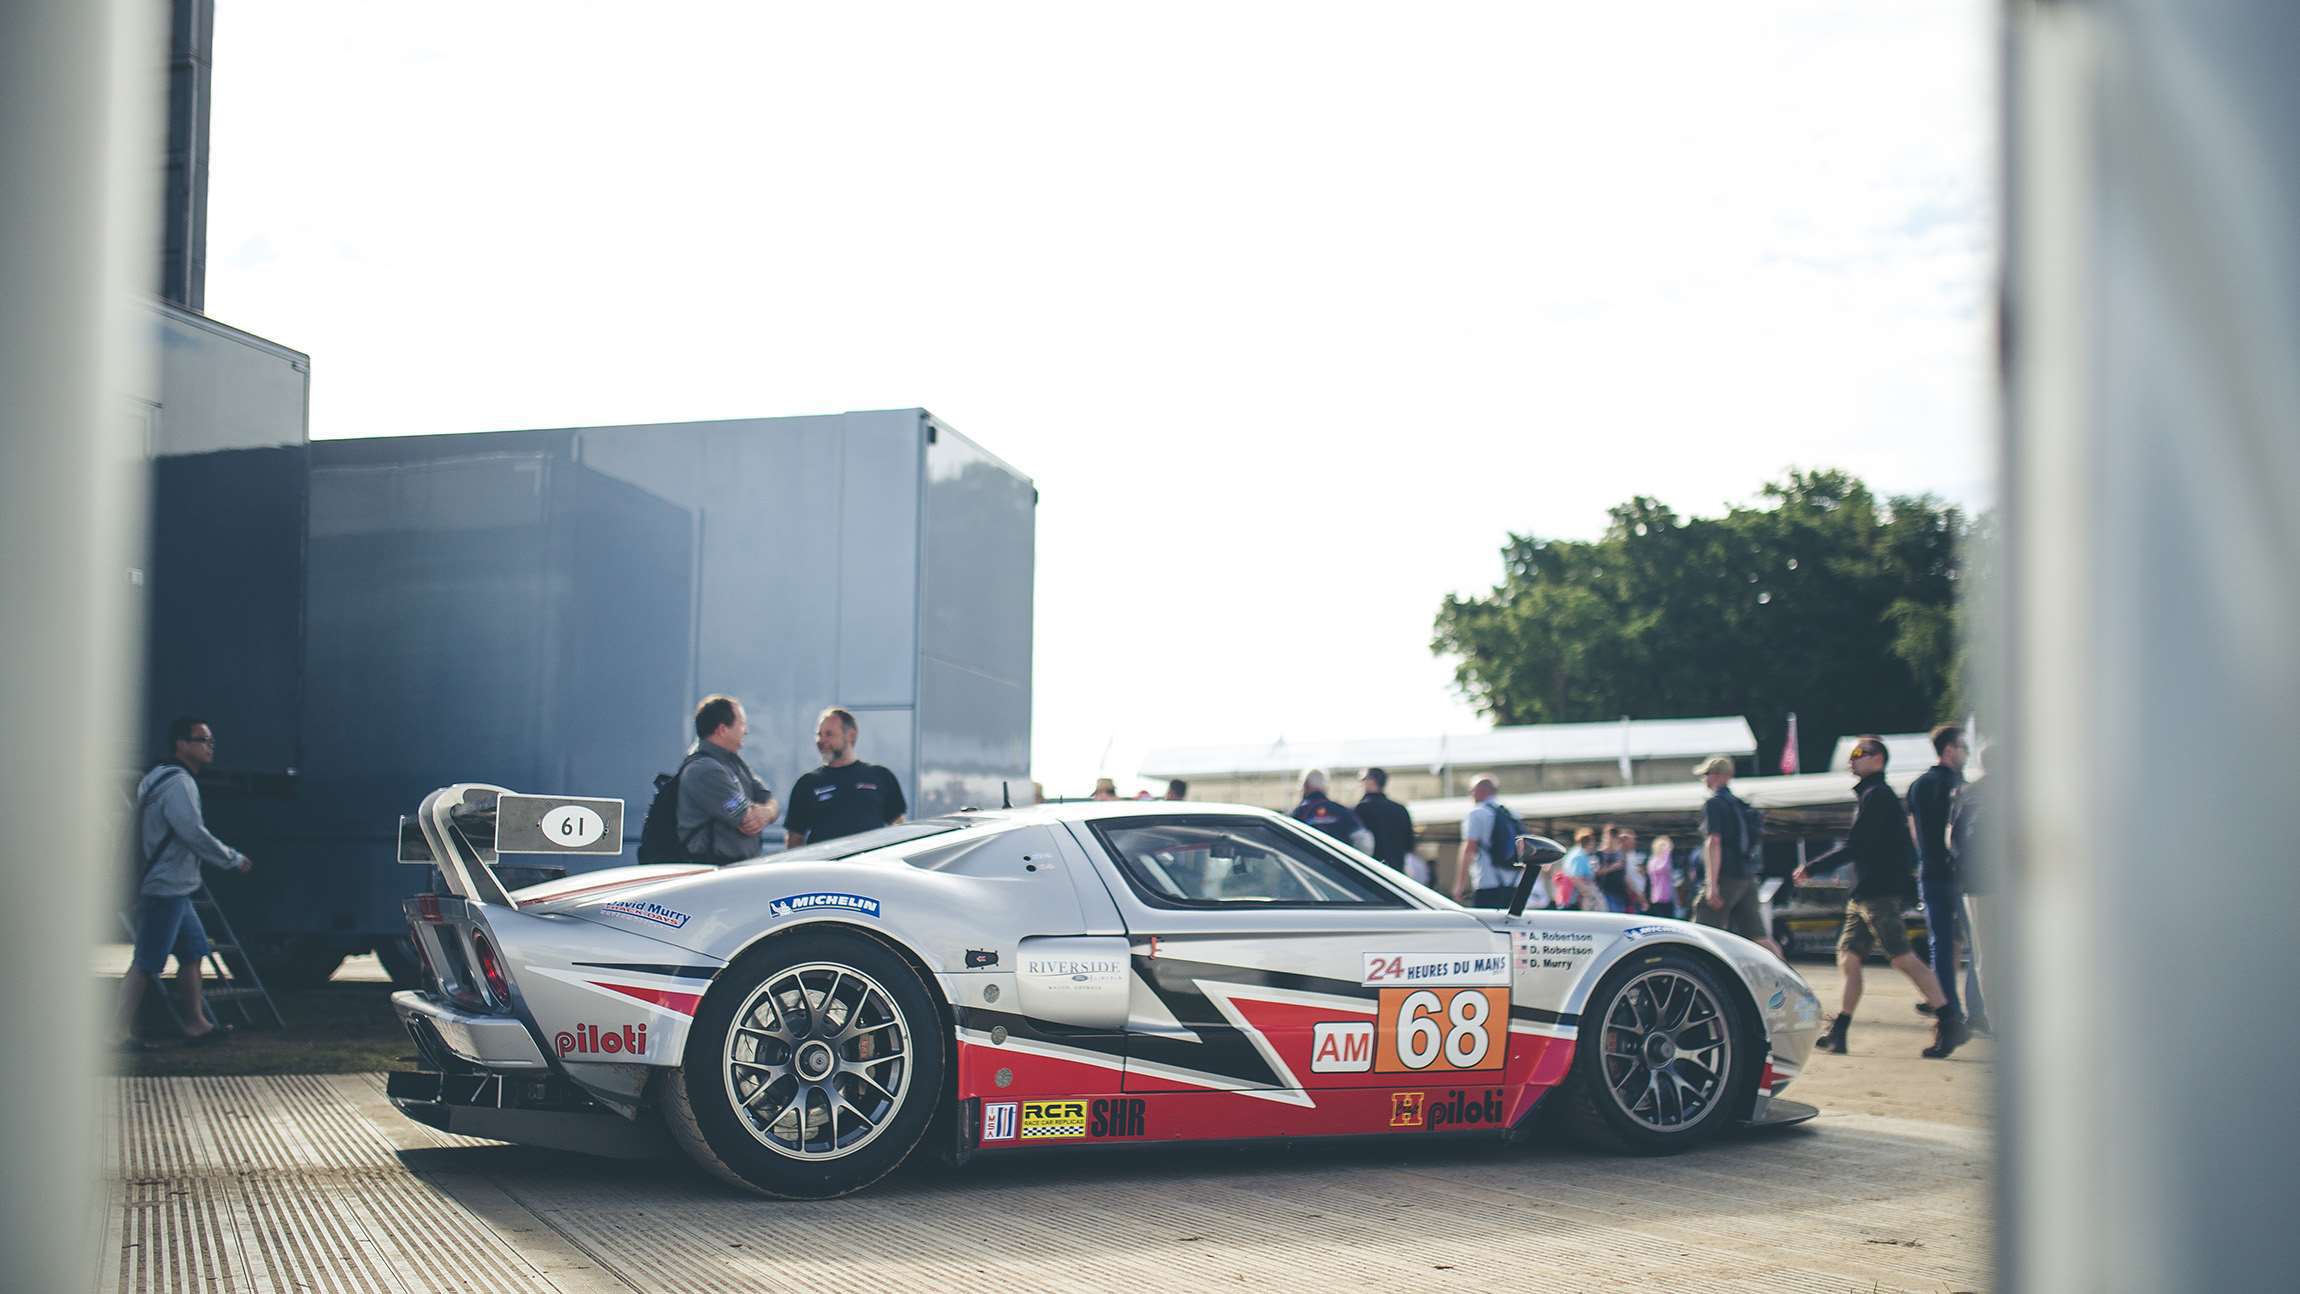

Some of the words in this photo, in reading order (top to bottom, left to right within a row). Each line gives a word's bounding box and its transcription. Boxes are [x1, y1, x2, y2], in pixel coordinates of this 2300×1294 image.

[561, 816, 584, 836] 61
[647, 903, 691, 922] Murry
[791, 894, 878, 912] MICHELIN
[1542, 932, 1593, 941] Robertson
[1543, 946, 1594, 955] Robertson
[1029, 960, 1121, 974] RIVERSIDE
[1366, 956, 1405, 982] 24
[1407, 963, 1448, 980] HEURES
[1453, 960, 1470, 975] DU
[1474, 956, 1506, 972] MANS
[1543, 960, 1572, 970] Murry
[1396, 989, 1490, 1070] 68
[554, 1022, 647, 1058] piloti
[1316, 1033, 1370, 1062] AM
[1025, 1103, 1084, 1119] RCR
[1091, 1099, 1146, 1137] SHR
[1427, 1089, 1504, 1131] piloti
